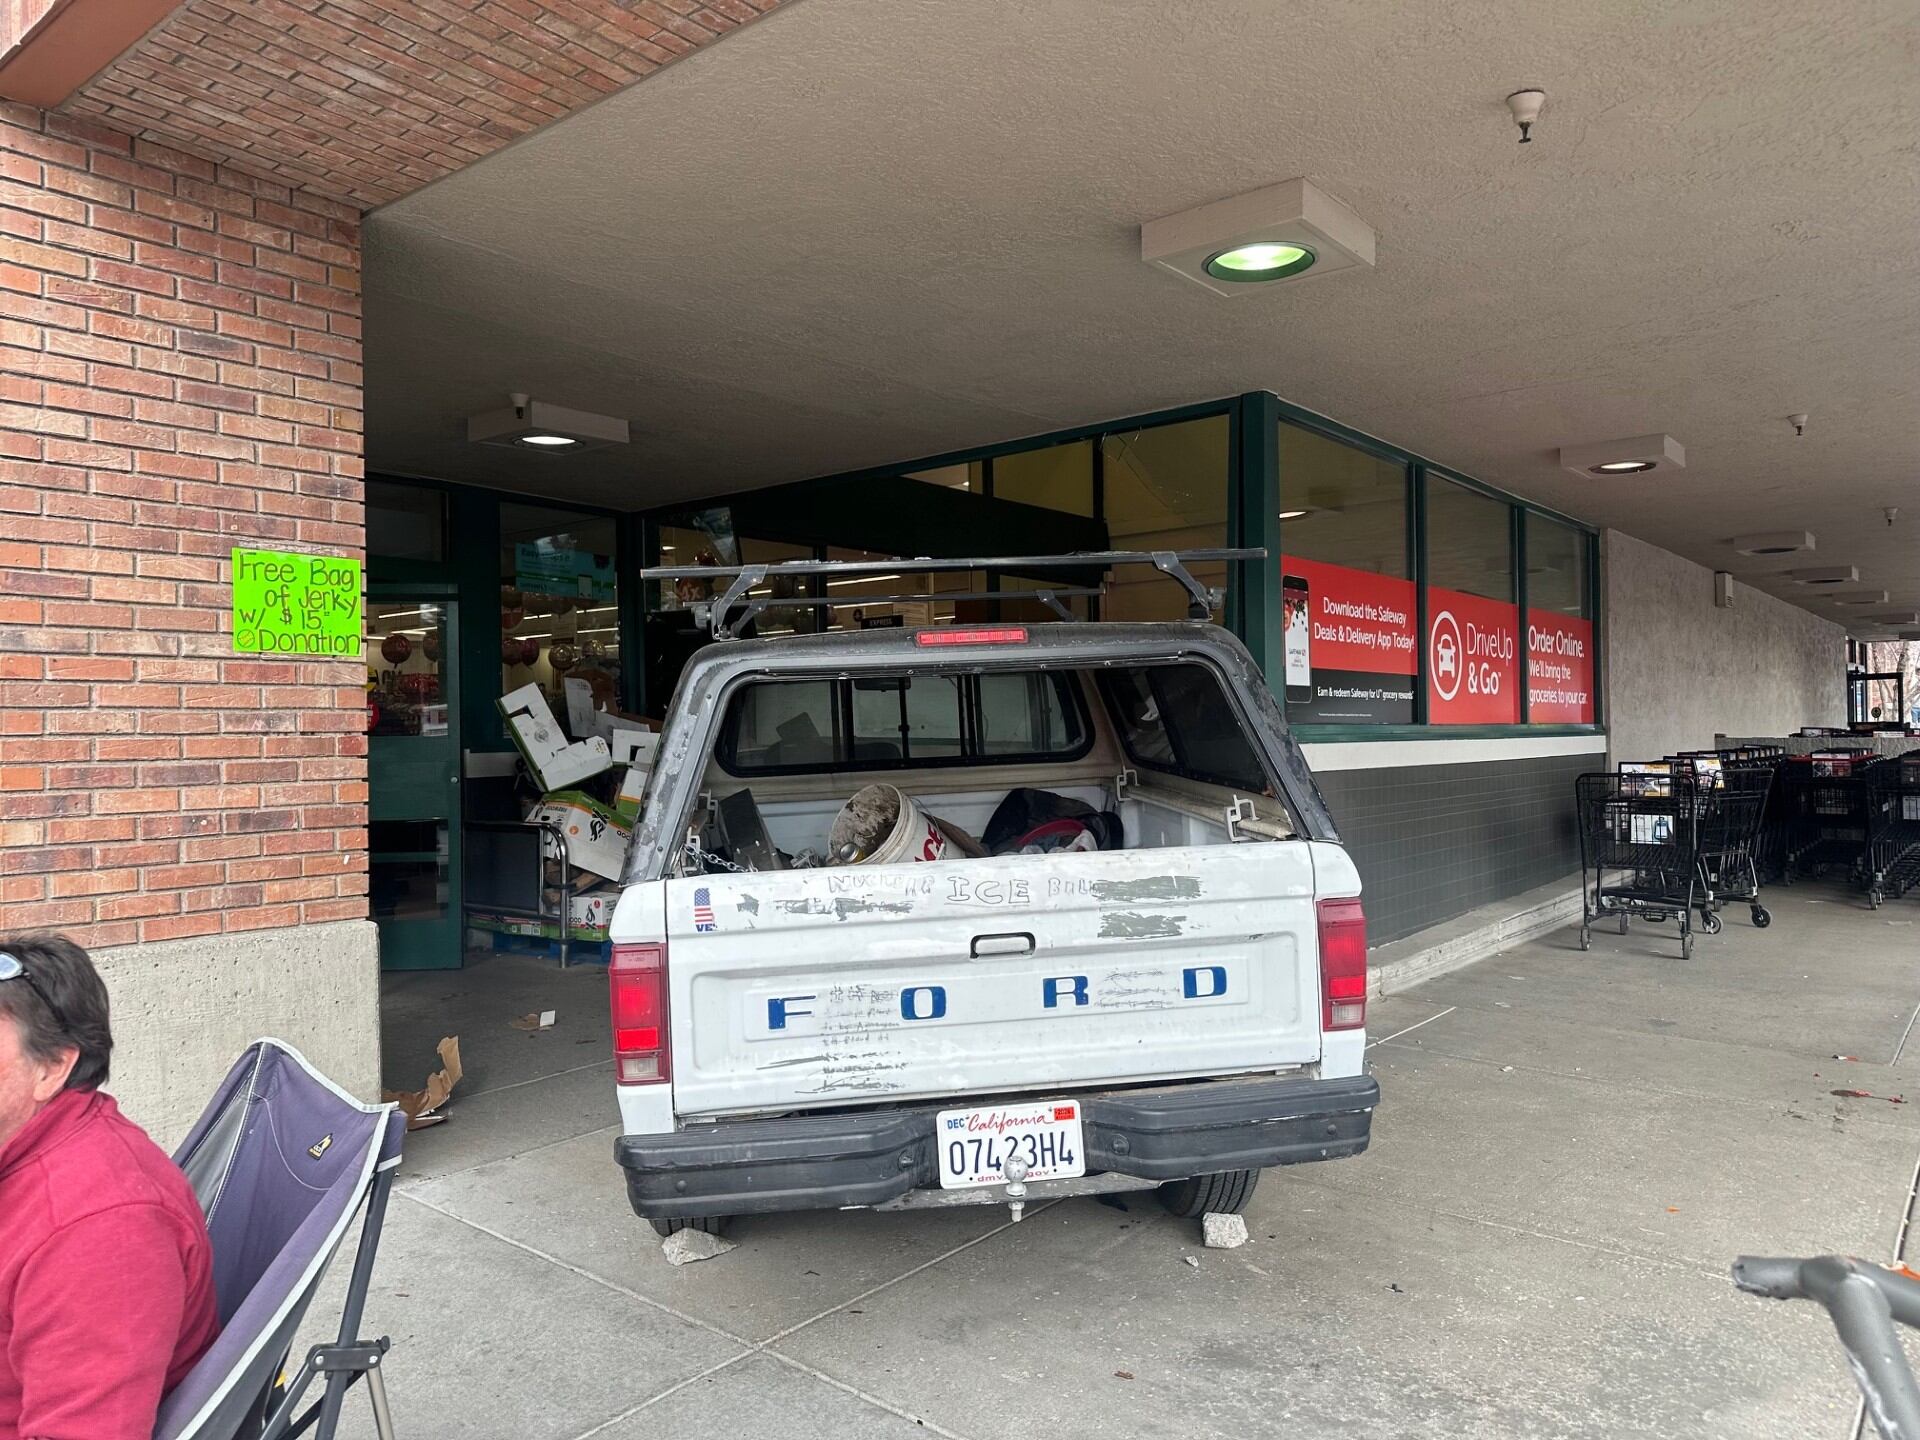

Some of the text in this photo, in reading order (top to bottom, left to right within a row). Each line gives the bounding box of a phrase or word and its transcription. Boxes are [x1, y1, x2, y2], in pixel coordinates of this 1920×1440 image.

[238, 551, 354, 593] Free Bag
[264, 584, 357, 619] of Jerky
[1323, 597, 1407, 628] Download the Safeway
[258, 626, 361, 655] Donation
[1314, 622, 1415, 653] Deals & Delivery App Today!
[1467, 623, 1513, 667] DriveUp
[1528, 625, 1585, 658] Order Online.
[1468, 662, 1478, 694] &
[1528, 659, 1571, 683] We'll bring the
[1317, 686, 1328, 697] Earn
[1333, 688, 1350, 698] redeem
[1351, 688, 1368, 700] Safeway
[1383, 691, 1398, 701] grocery
[1529, 687, 1557, 706] groceries
[1558, 689, 1565, 703] to
[1565, 691, 1578, 708] your
[947, 876, 1030, 904] ICE
[767, 965, 1227, 1031] FORD
[947, 1118, 965, 1130] DEC
[967, 1111, 1055, 1135] California
[949, 1130, 1075, 1176] 07423H4
